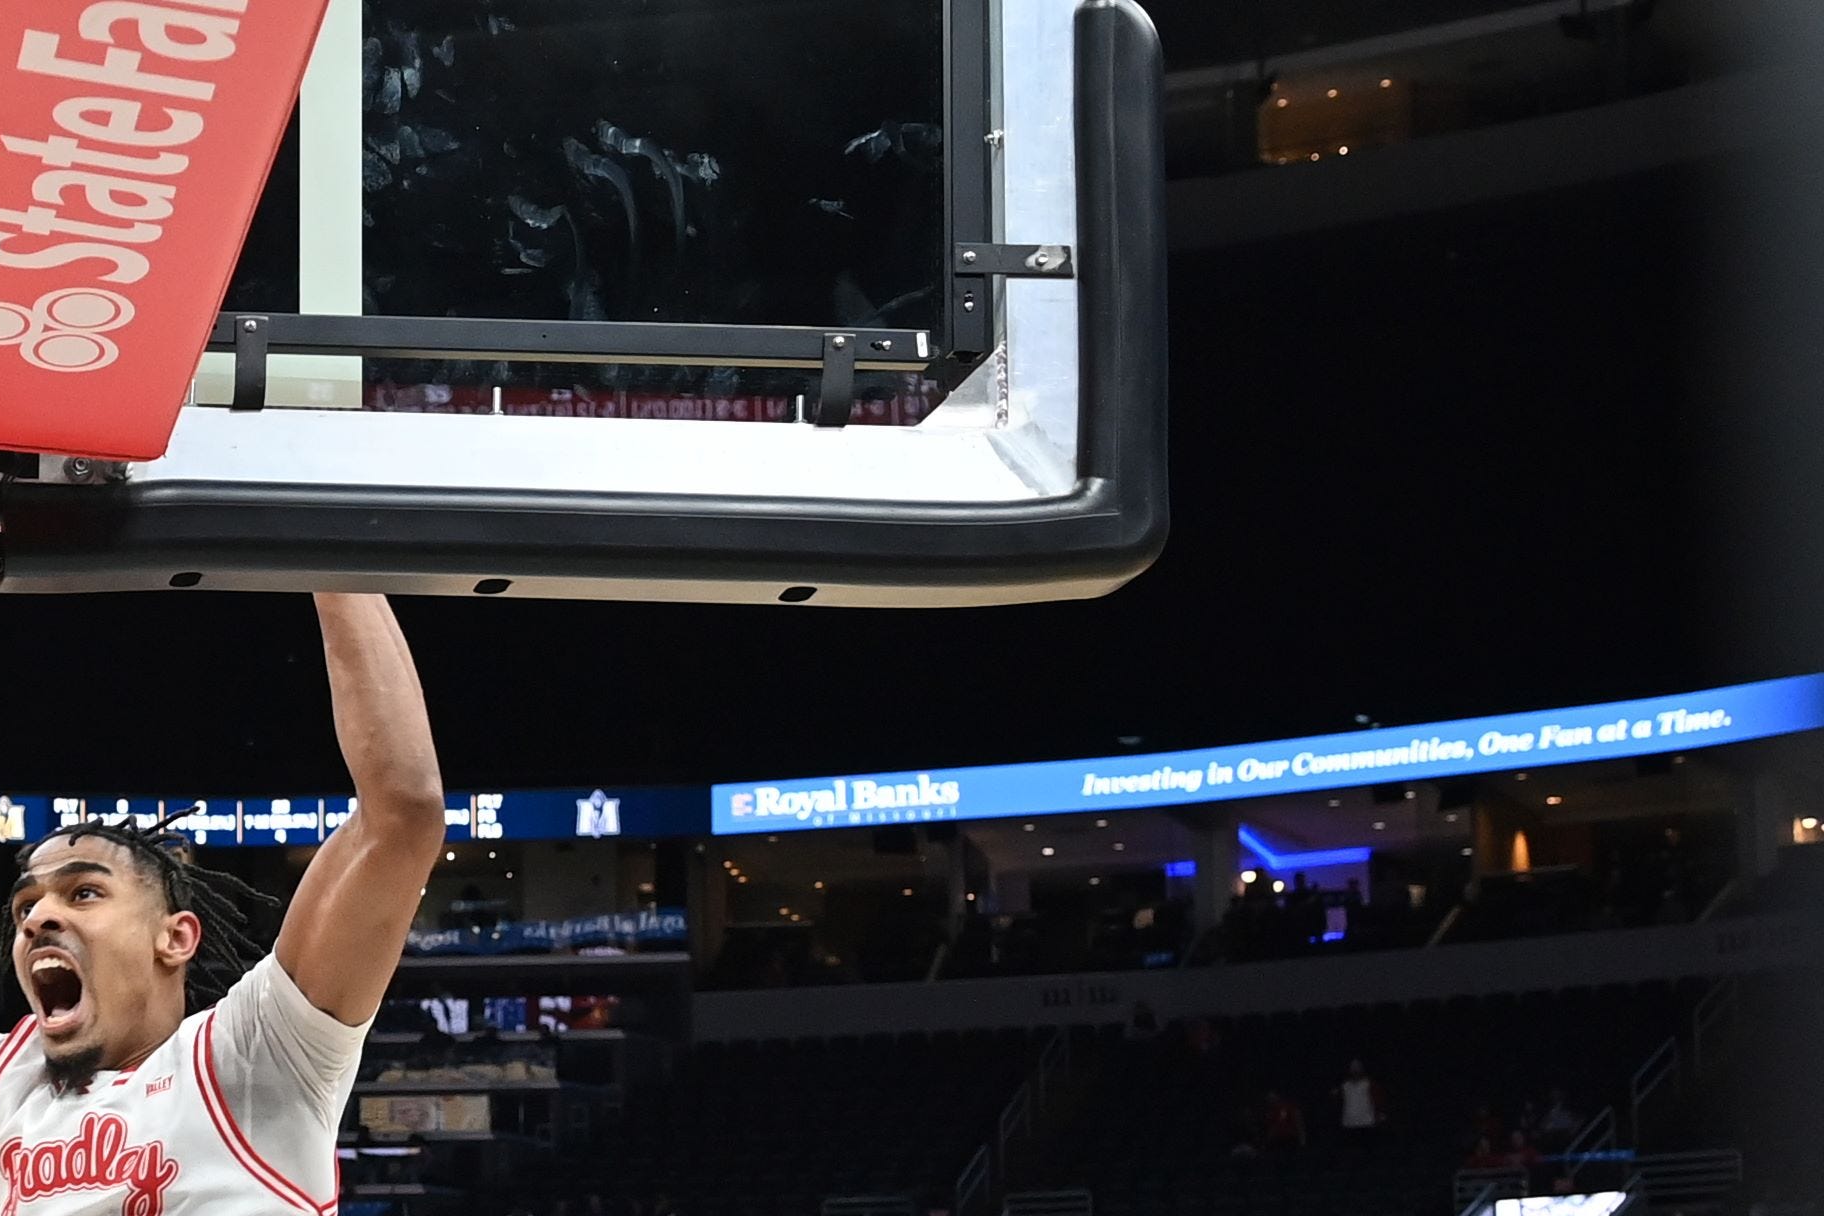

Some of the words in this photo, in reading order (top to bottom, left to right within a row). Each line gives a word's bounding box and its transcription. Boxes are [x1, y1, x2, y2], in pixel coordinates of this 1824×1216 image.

[1081, 766, 1203, 798] Investing
[1207, 762, 1234, 786] in
[1237, 758, 1289, 783] Our
[1292, 737, 1474, 777] Communities,
[1478, 731, 1534, 756] One
[1538, 723, 1593, 750] Fan
[1596, 718, 1627, 741] at
[1631, 719, 1652, 739] a
[1656, 708, 1732, 736] Time.
[754, 779, 848, 820] Royal
[851, 774, 960, 810] Banks
